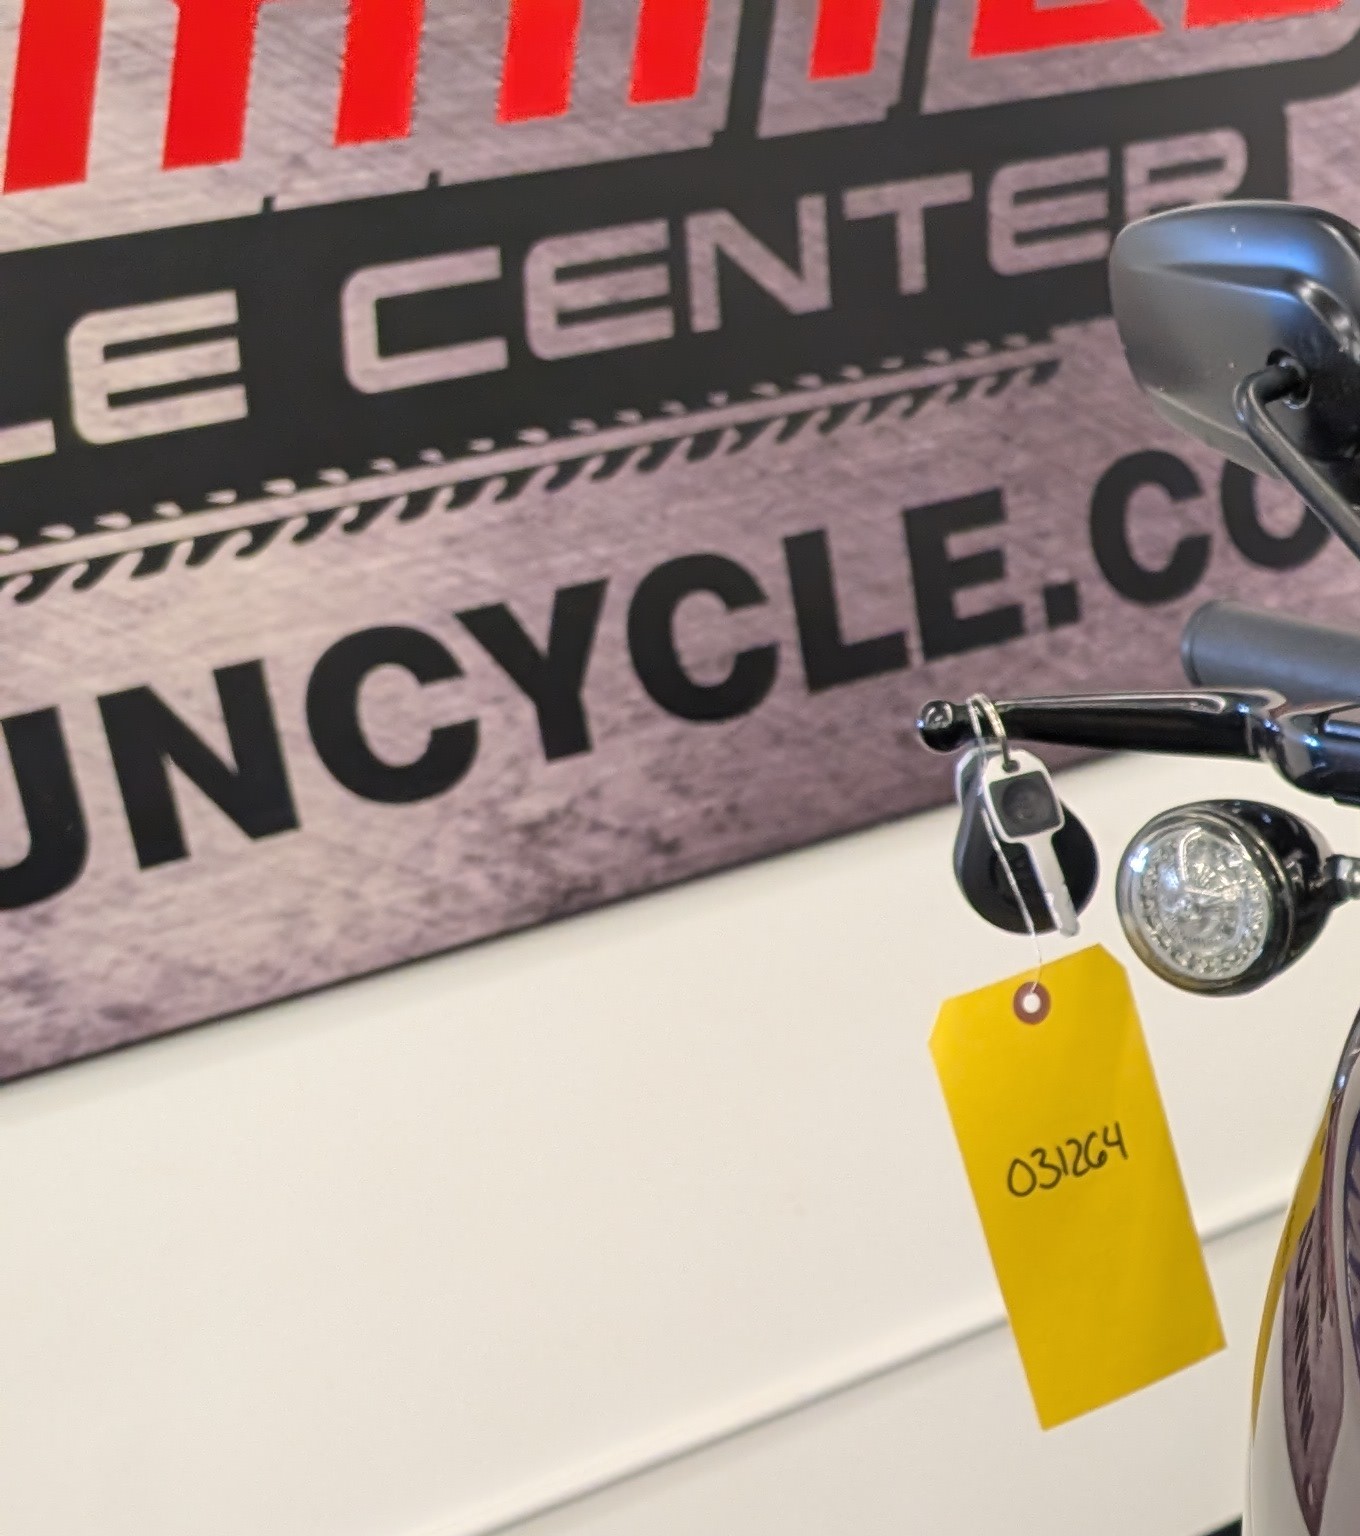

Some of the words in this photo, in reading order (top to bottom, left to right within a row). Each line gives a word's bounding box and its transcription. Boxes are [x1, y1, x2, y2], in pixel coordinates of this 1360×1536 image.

[0, 290, 248, 463] E
[340, 127, 1247, 394] CENTER
[1006, 1120, 1129, 1198] 031264
